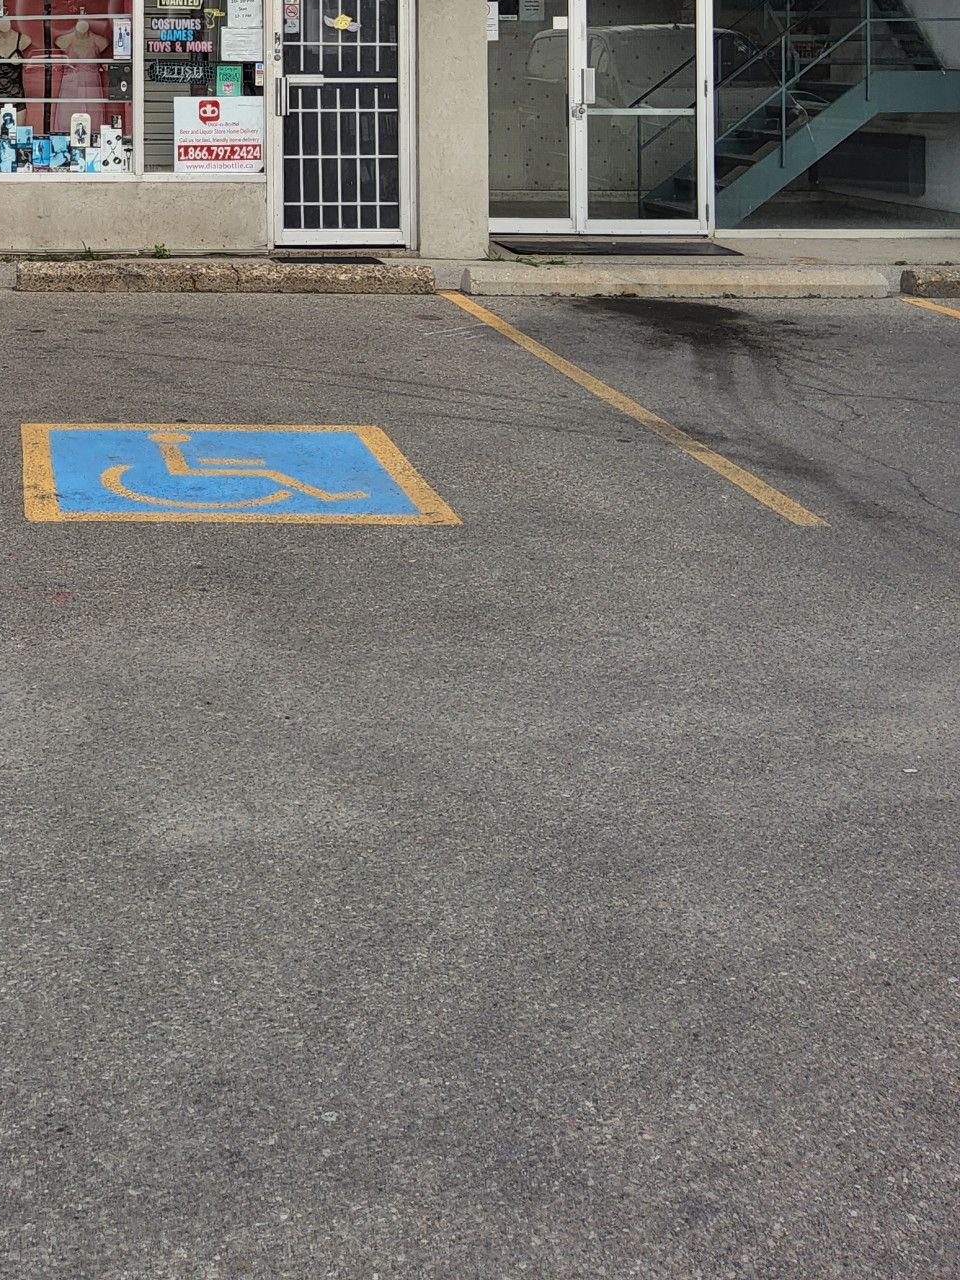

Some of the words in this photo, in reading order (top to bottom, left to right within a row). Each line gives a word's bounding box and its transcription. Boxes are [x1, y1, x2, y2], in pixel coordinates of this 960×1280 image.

[151, 18, 202, 30] COSTUMES
[160, 30, 194, 41] GAMES
[147, 41, 172, 52] TOYS
[175, 41, 183, 52] &
[186, 41, 213, 52] MORE
[178, 146, 261, 160] 1.866.797.2424
